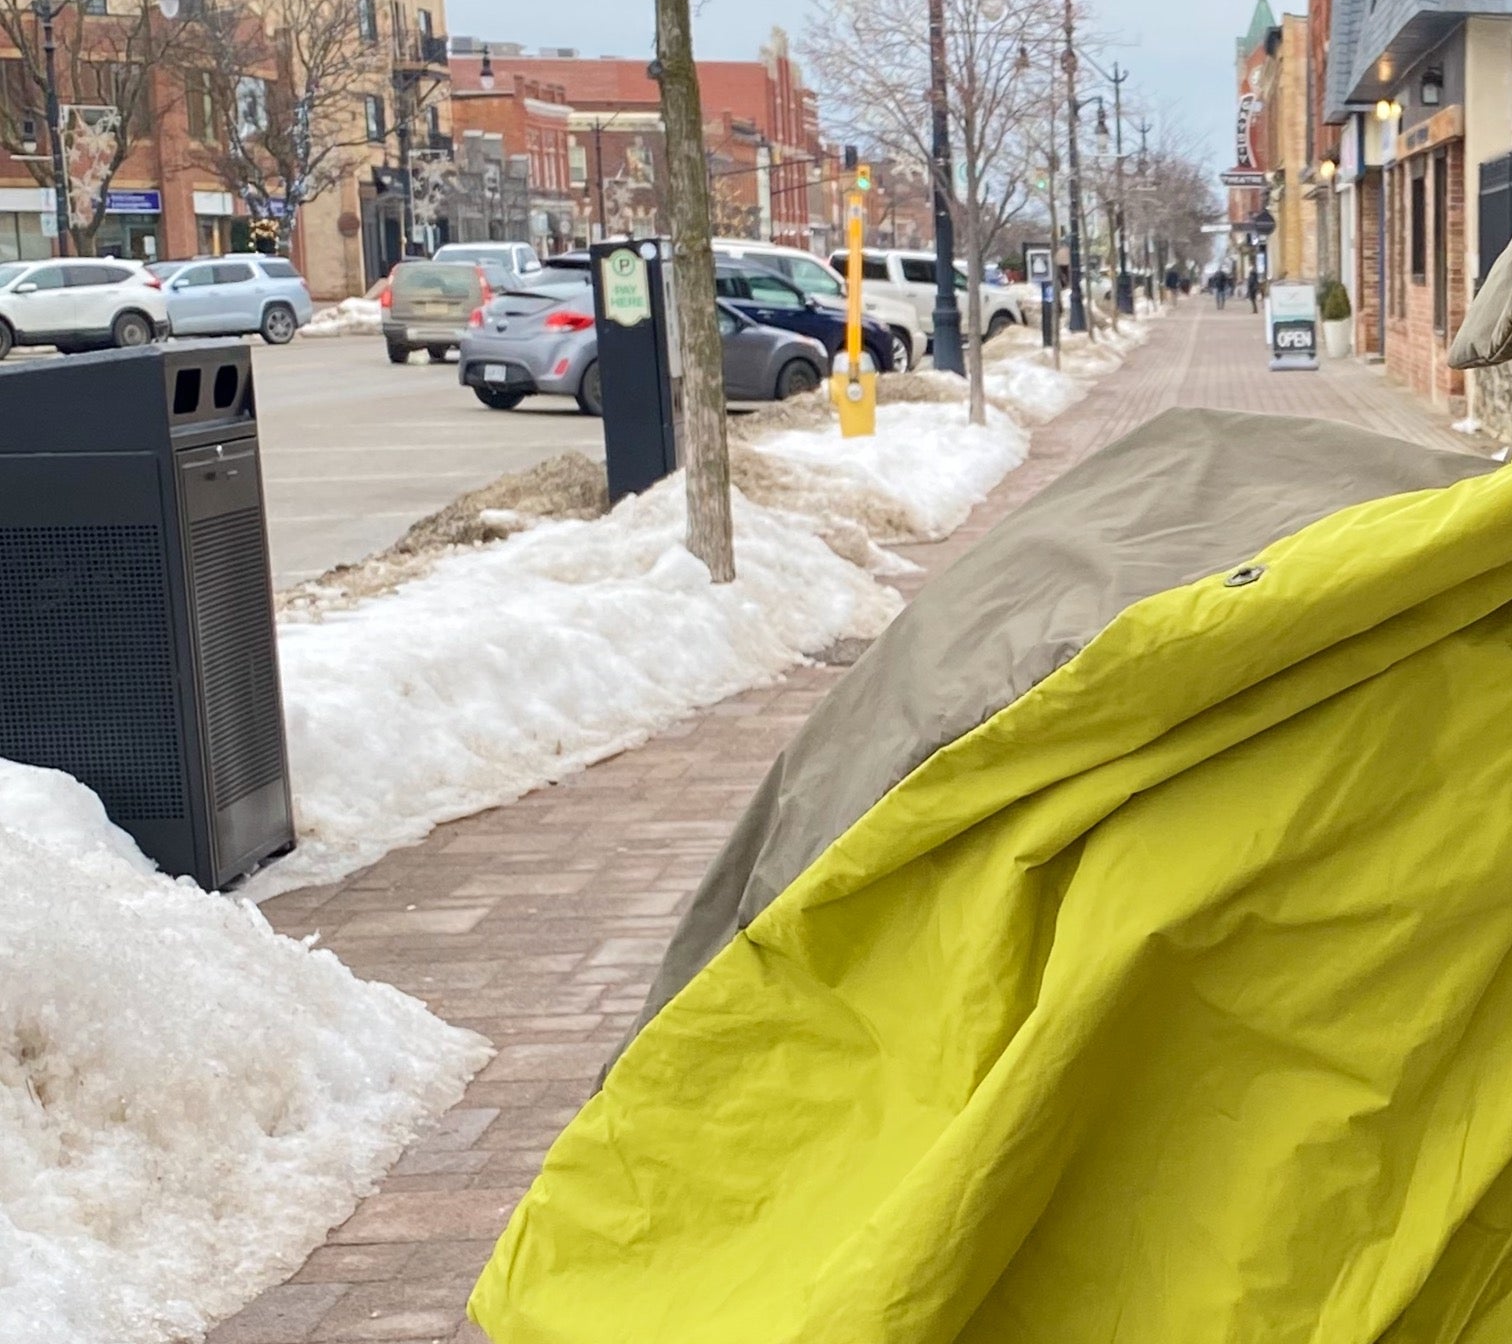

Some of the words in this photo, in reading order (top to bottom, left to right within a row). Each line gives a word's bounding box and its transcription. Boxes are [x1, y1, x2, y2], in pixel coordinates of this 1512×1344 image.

[619, 258, 630, 273] P
[614, 285, 637, 295] PAY
[610, 296, 644, 308] HERE
[1277, 330, 1312, 347] OPEN
